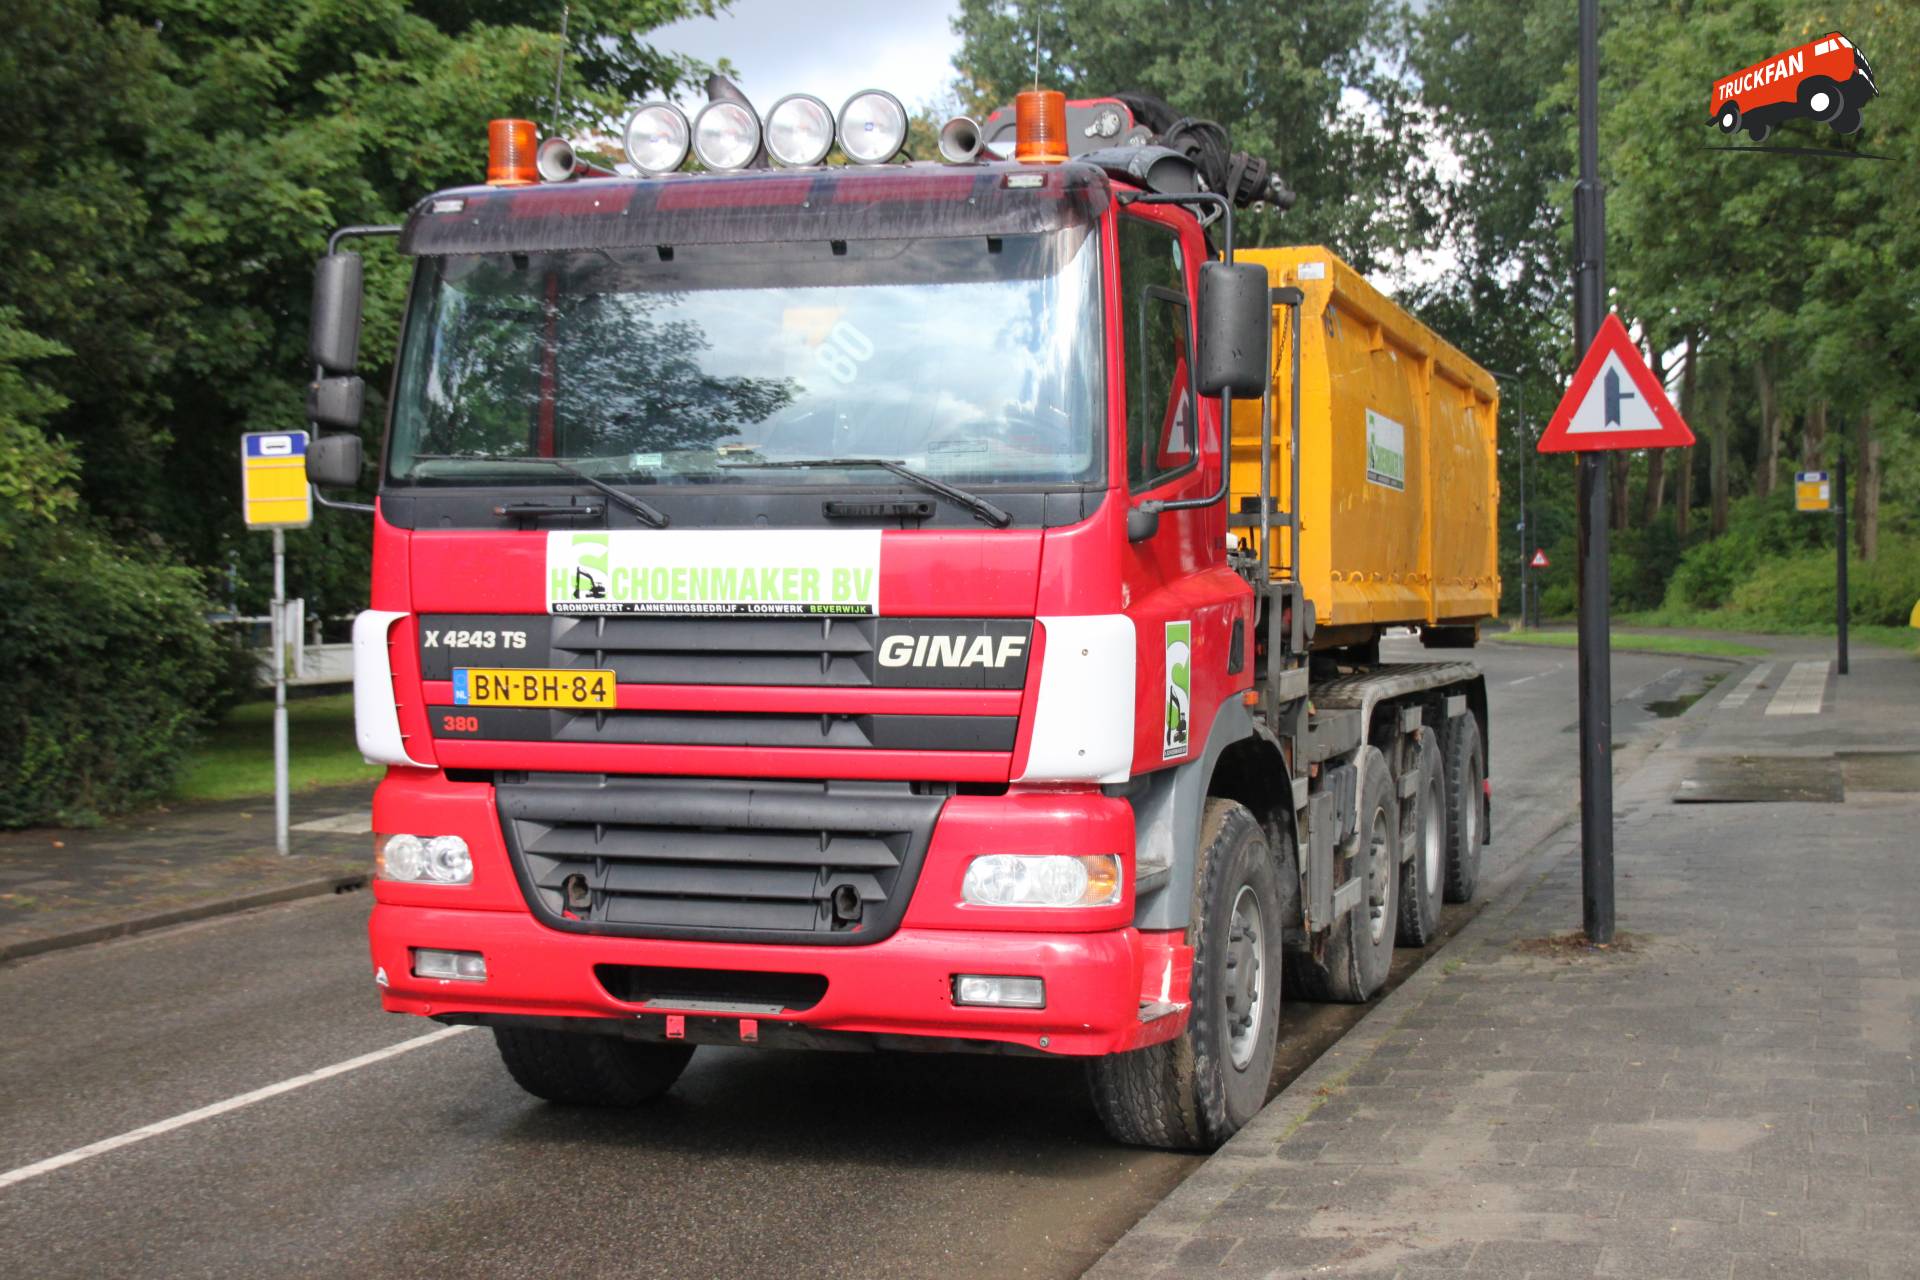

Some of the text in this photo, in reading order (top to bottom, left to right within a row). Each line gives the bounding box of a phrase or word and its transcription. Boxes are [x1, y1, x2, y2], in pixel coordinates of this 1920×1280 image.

[815, 320, 874, 383] 80
[831, 567, 874, 602] BV
[556, 603, 623, 612] GRONDVERZET
[633, 603, 737, 613] AANNEMINGSBEDRIJF
[748, 604, 803, 613] LOONWERK
[809, 604, 867, 613] BEVERWIJK
[424, 630, 527, 649] X 4243 TS
[878, 635, 1026, 668] GINAF
[455, 690, 467, 700] NL
[475, 675, 606, 702] BN-BH-84
[443, 716, 478, 732] 380
